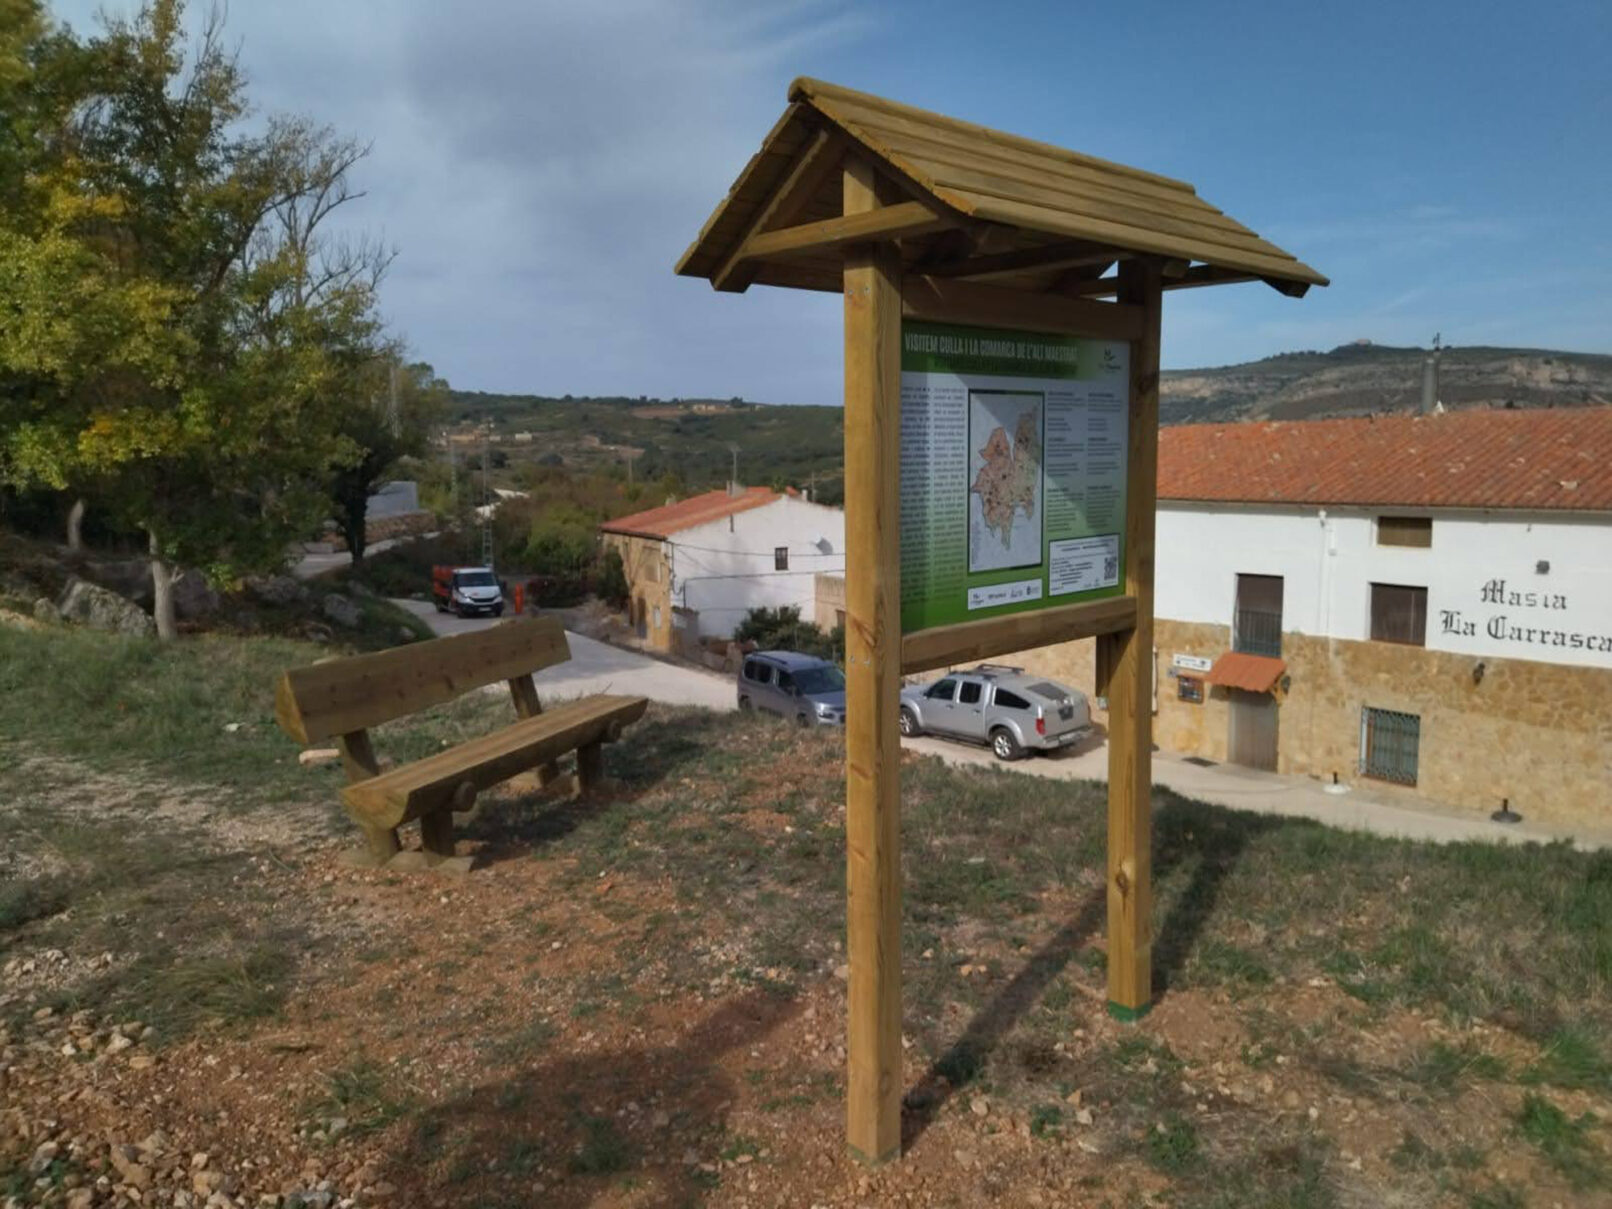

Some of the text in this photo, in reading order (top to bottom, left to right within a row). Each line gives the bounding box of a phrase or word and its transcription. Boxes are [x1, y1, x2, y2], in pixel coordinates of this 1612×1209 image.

[904, 333, 938, 352] VISITEM
[939, 336, 963, 354] CULLA
[969, 338, 979, 356] LA
[1440, 609, 1612, 653] La Carrasca
